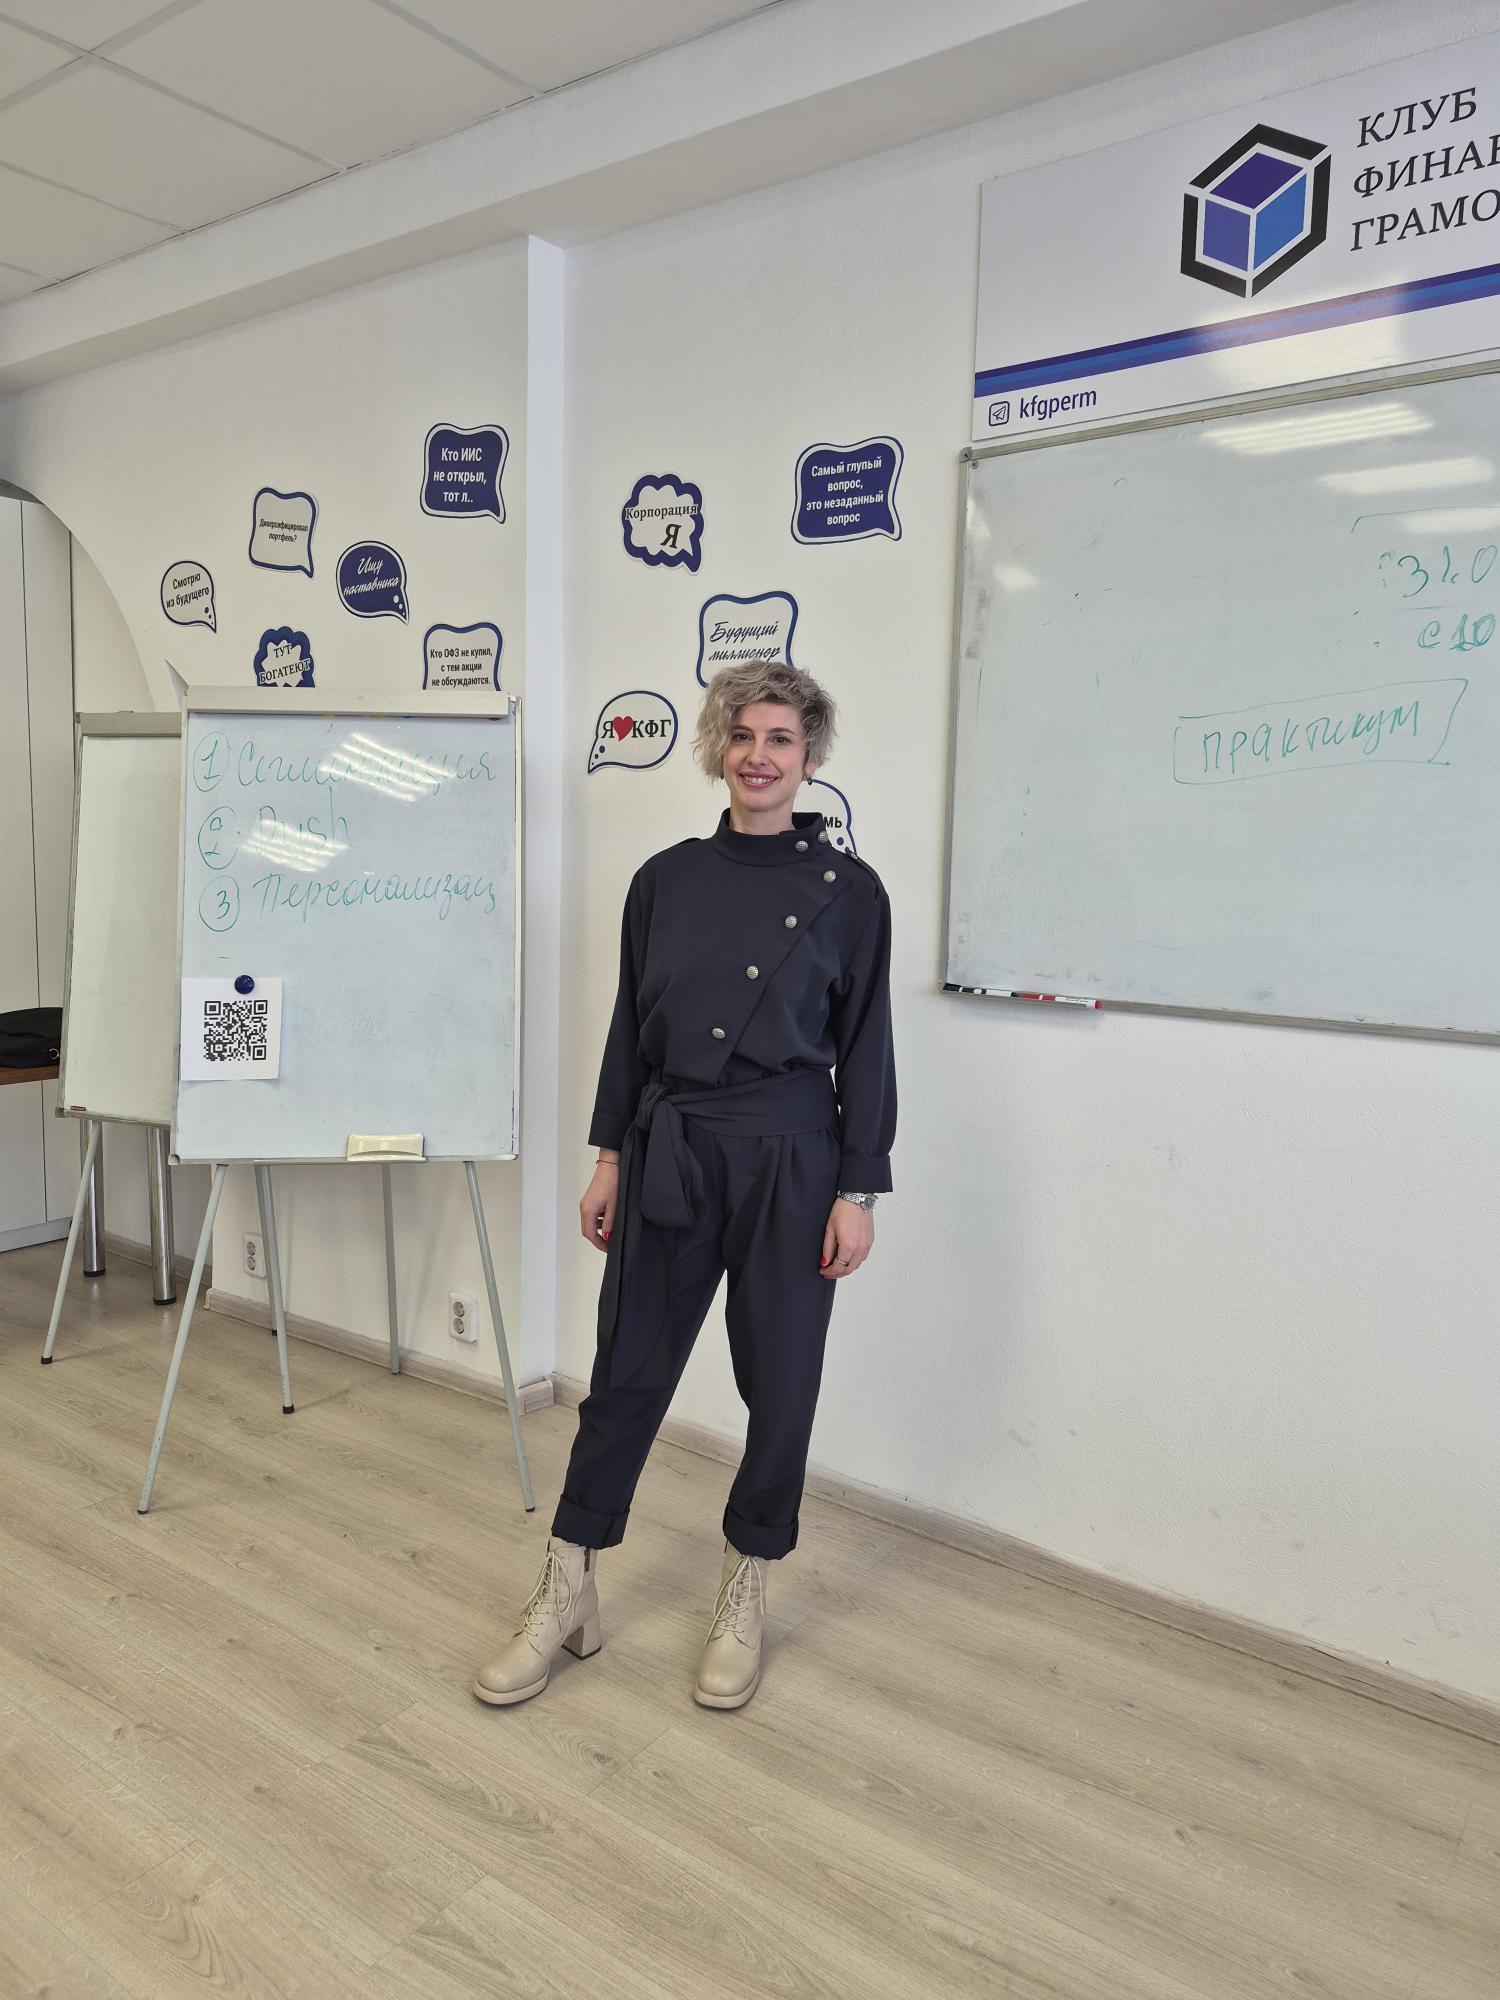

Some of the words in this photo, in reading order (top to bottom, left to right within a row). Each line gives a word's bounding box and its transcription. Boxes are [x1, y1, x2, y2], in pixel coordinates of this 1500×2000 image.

[1357, 87, 1477, 148] КЛУБ
[1350, 189, 1500, 252] ГРАМО
[1019, 390, 1097, 421] kfgperm
[441, 447, 459, 462] Кто
[461, 447, 482, 462] ИИС
[811, 461, 845, 477] Самый
[846, 455, 882, 474] глупый
[433, 471, 445, 482] не
[446, 471, 487, 486] открыл,
[827, 479, 863, 492] вопрос,
[443, 491, 460, 503] тот
[806, 501, 822, 511] это
[824, 490, 884, 509] незаданный
[626, 504, 698, 522] Корпорация
[827, 513, 861, 526] вопрос
[268, 532, 298, 543] портфель?
[660, 523, 682, 549] Я
[357, 556, 384, 576] Ищу
[172, 572, 201, 590] Смотрю
[343, 576, 400, 597] наставника
[166, 598, 175, 609] из
[176, 586, 210, 607] будущего
[709, 620, 779, 645] Будущий
[273, 645, 292, 658] ТУТ
[430, 649, 443, 659] Кто
[443, 647, 460, 658] ОФЗ
[460, 649, 470, 657] не
[470, 648, 493, 659] купил,
[708, 646, 781, 663] миллионер
[259, 659, 311, 683] БОГАТЕЮТ
[440, 664, 446, 672] с
[446, 664, 460, 672] тем
[461, 663, 482, 672] акции
[431, 679, 440, 687] не
[441, 676, 491, 688] обсуждаются.
[601, 720, 615, 739] Я
[631, 719, 672, 739] КФГ
